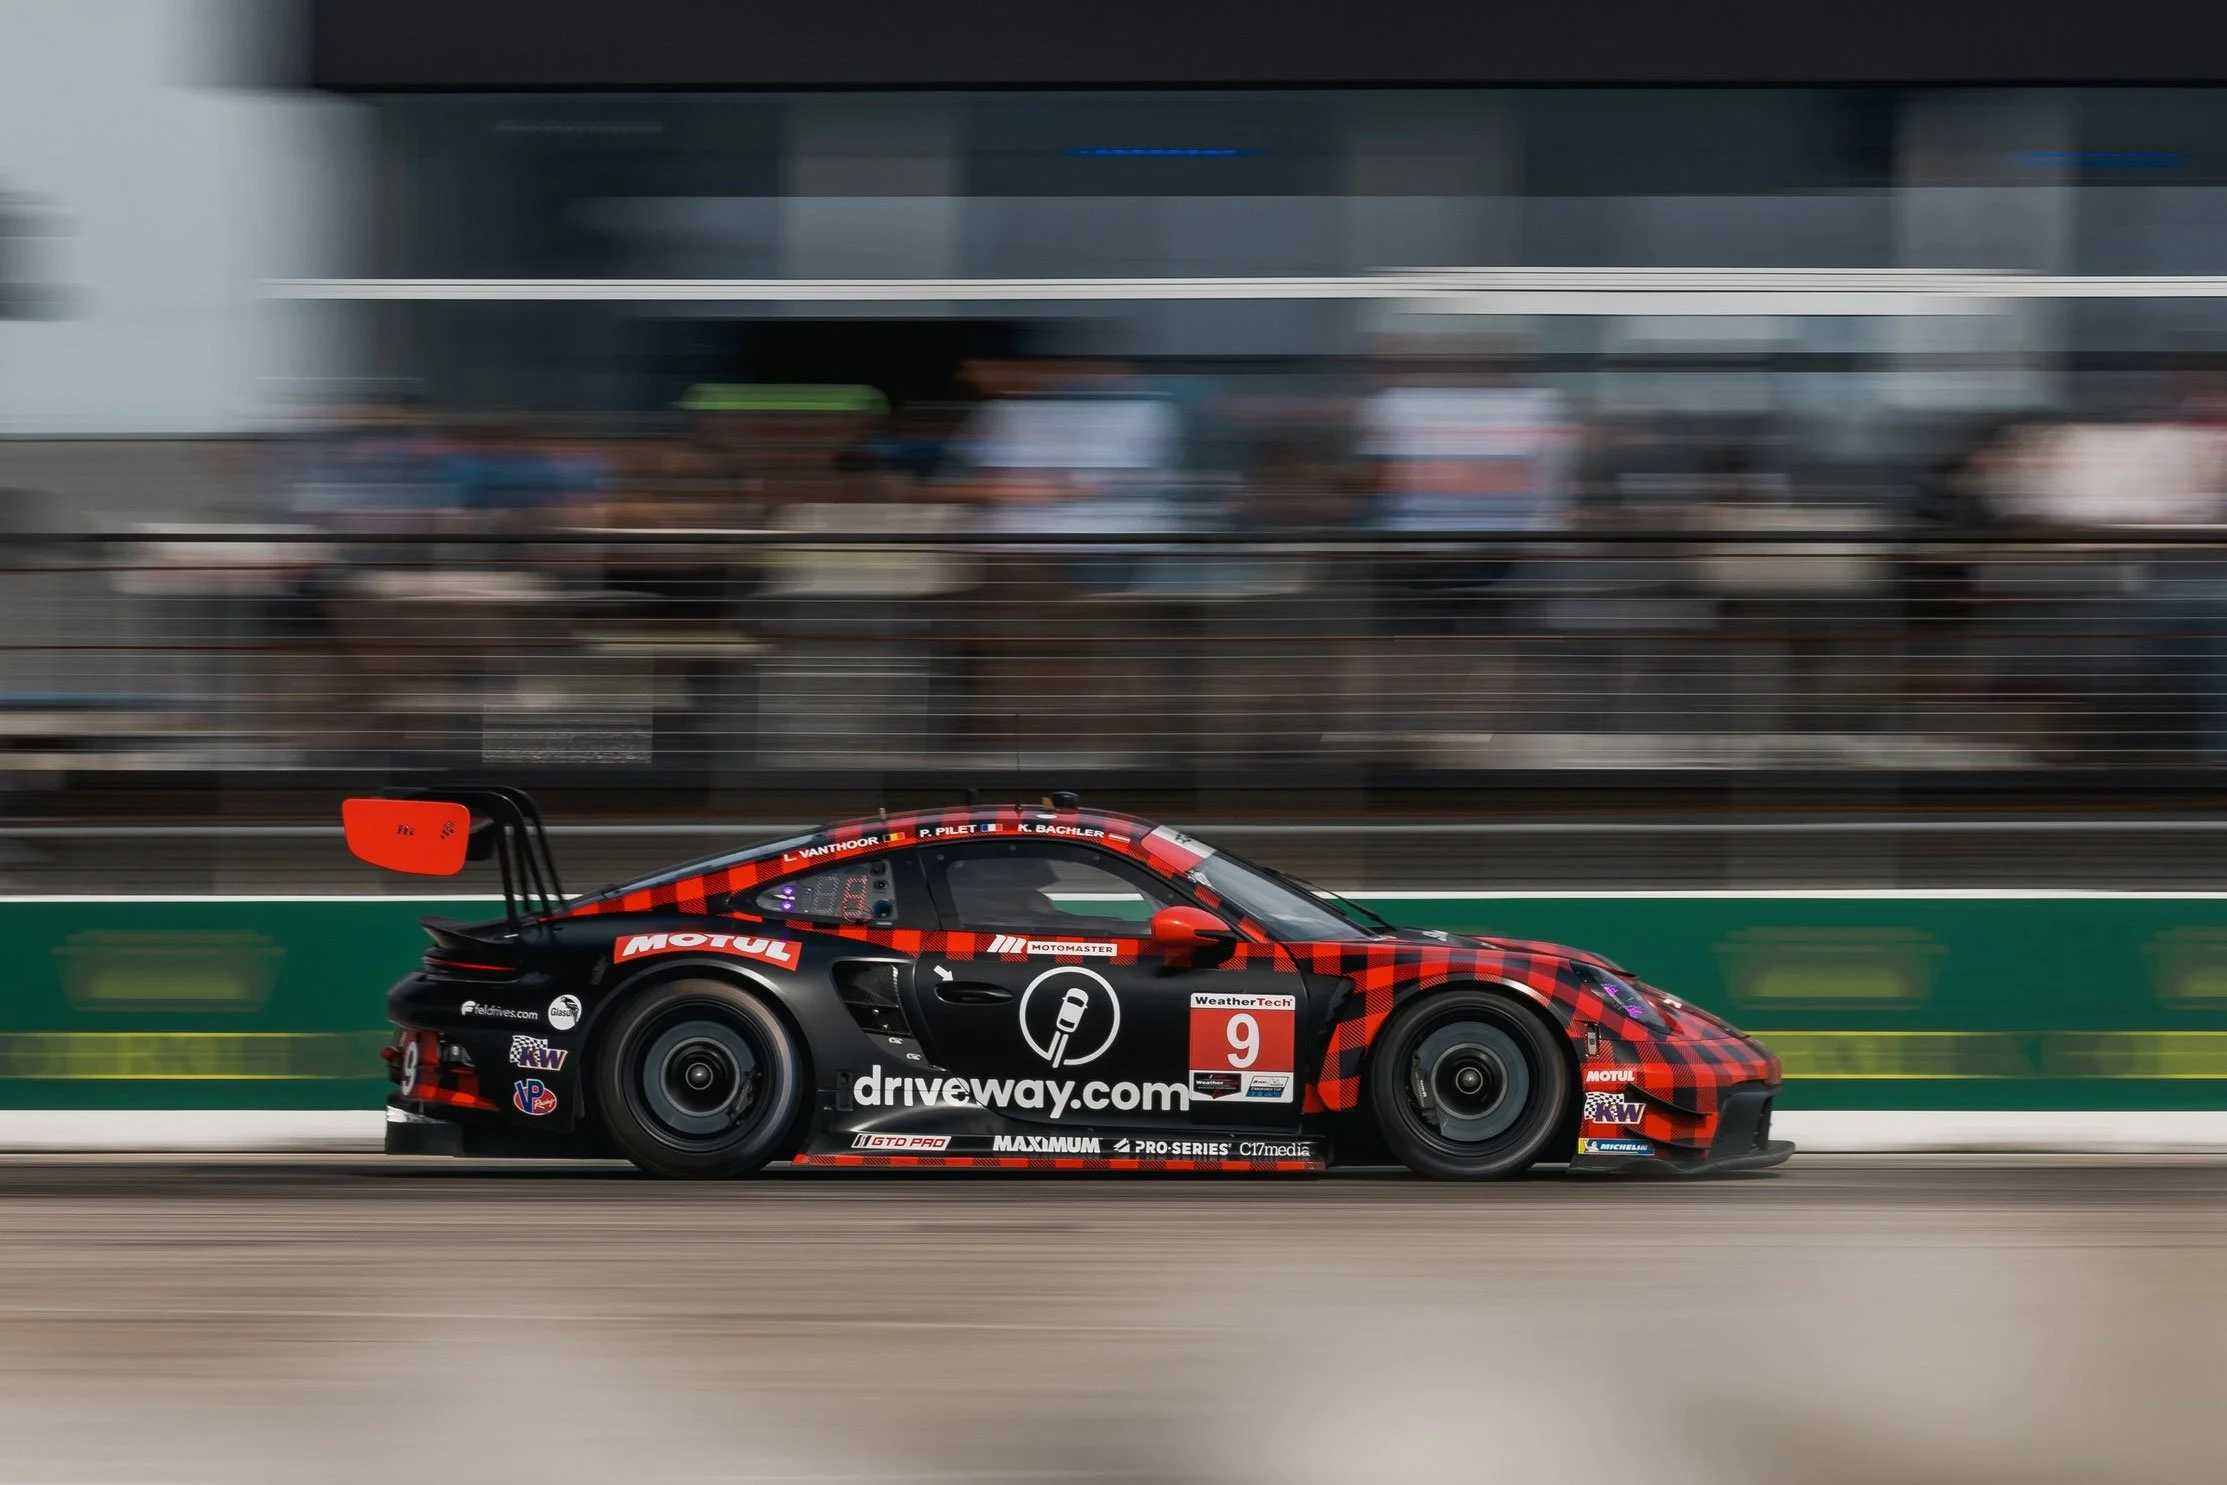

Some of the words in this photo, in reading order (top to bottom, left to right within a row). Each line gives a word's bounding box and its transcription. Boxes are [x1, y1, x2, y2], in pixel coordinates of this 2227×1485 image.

[919, 828, 933, 838] P.
[936, 824, 977, 836] PILET
[1017, 823, 1032, 833] K.
[1035, 824, 1105, 838] BACHLER
[783, 853, 798, 862] L.
[798, 836, 880, 859] VANTHOOR
[622, 933, 792, 962] MOTUL
[1032, 944, 1113, 953] MOTOMASTER
[1195, 996, 1292, 1007] WeatherTech
[1226, 1013, 1260, 1069] 9
[520, 1047, 567, 1070] KW
[402, 1042, 418, 1096] 9
[1586, 1070, 1635, 1082] MOTUL
[514, 1079, 545, 1114] VP
[853, 1064, 1190, 1119] driveway.com
[1595, 1102, 1644, 1122] KW
[871, 1137, 907, 1146] GTD
[910, 1138, 946, 1148] PRO
[992, 1136, 1102, 1153] MAXIMUM
[1239, 1142, 1311, 1157] C17media
[1600, 1143, 1648, 1151] MICHELIN
